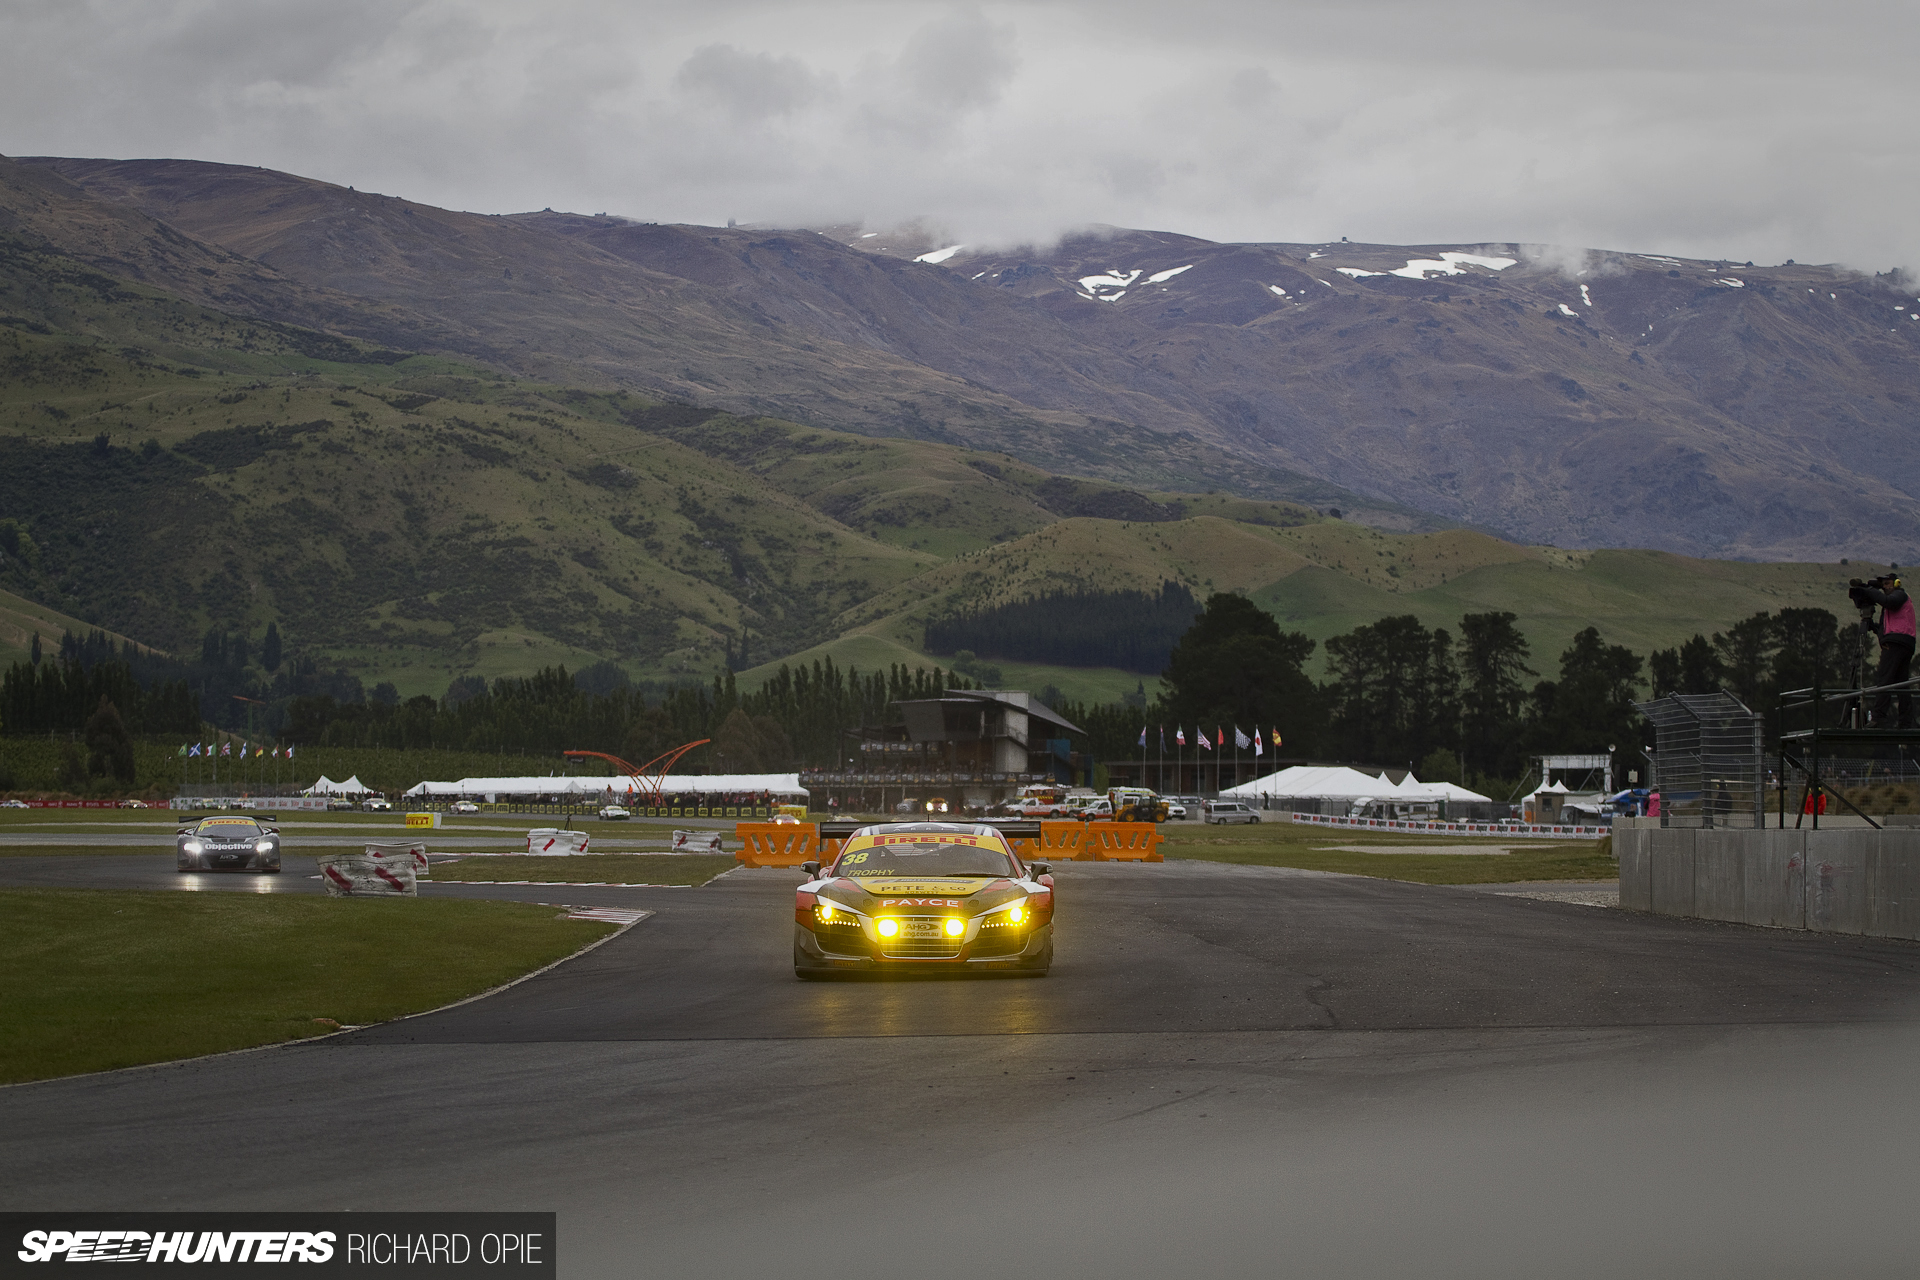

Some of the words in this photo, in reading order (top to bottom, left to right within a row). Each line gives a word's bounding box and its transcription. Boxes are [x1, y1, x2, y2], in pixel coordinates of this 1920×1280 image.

[873, 834, 979, 846] PIRELLI
[204, 843, 253, 851] Objective
[841, 852, 869, 866] 38
[847, 869, 895, 877] TROPHY
[882, 898, 959, 908] PAYCE
